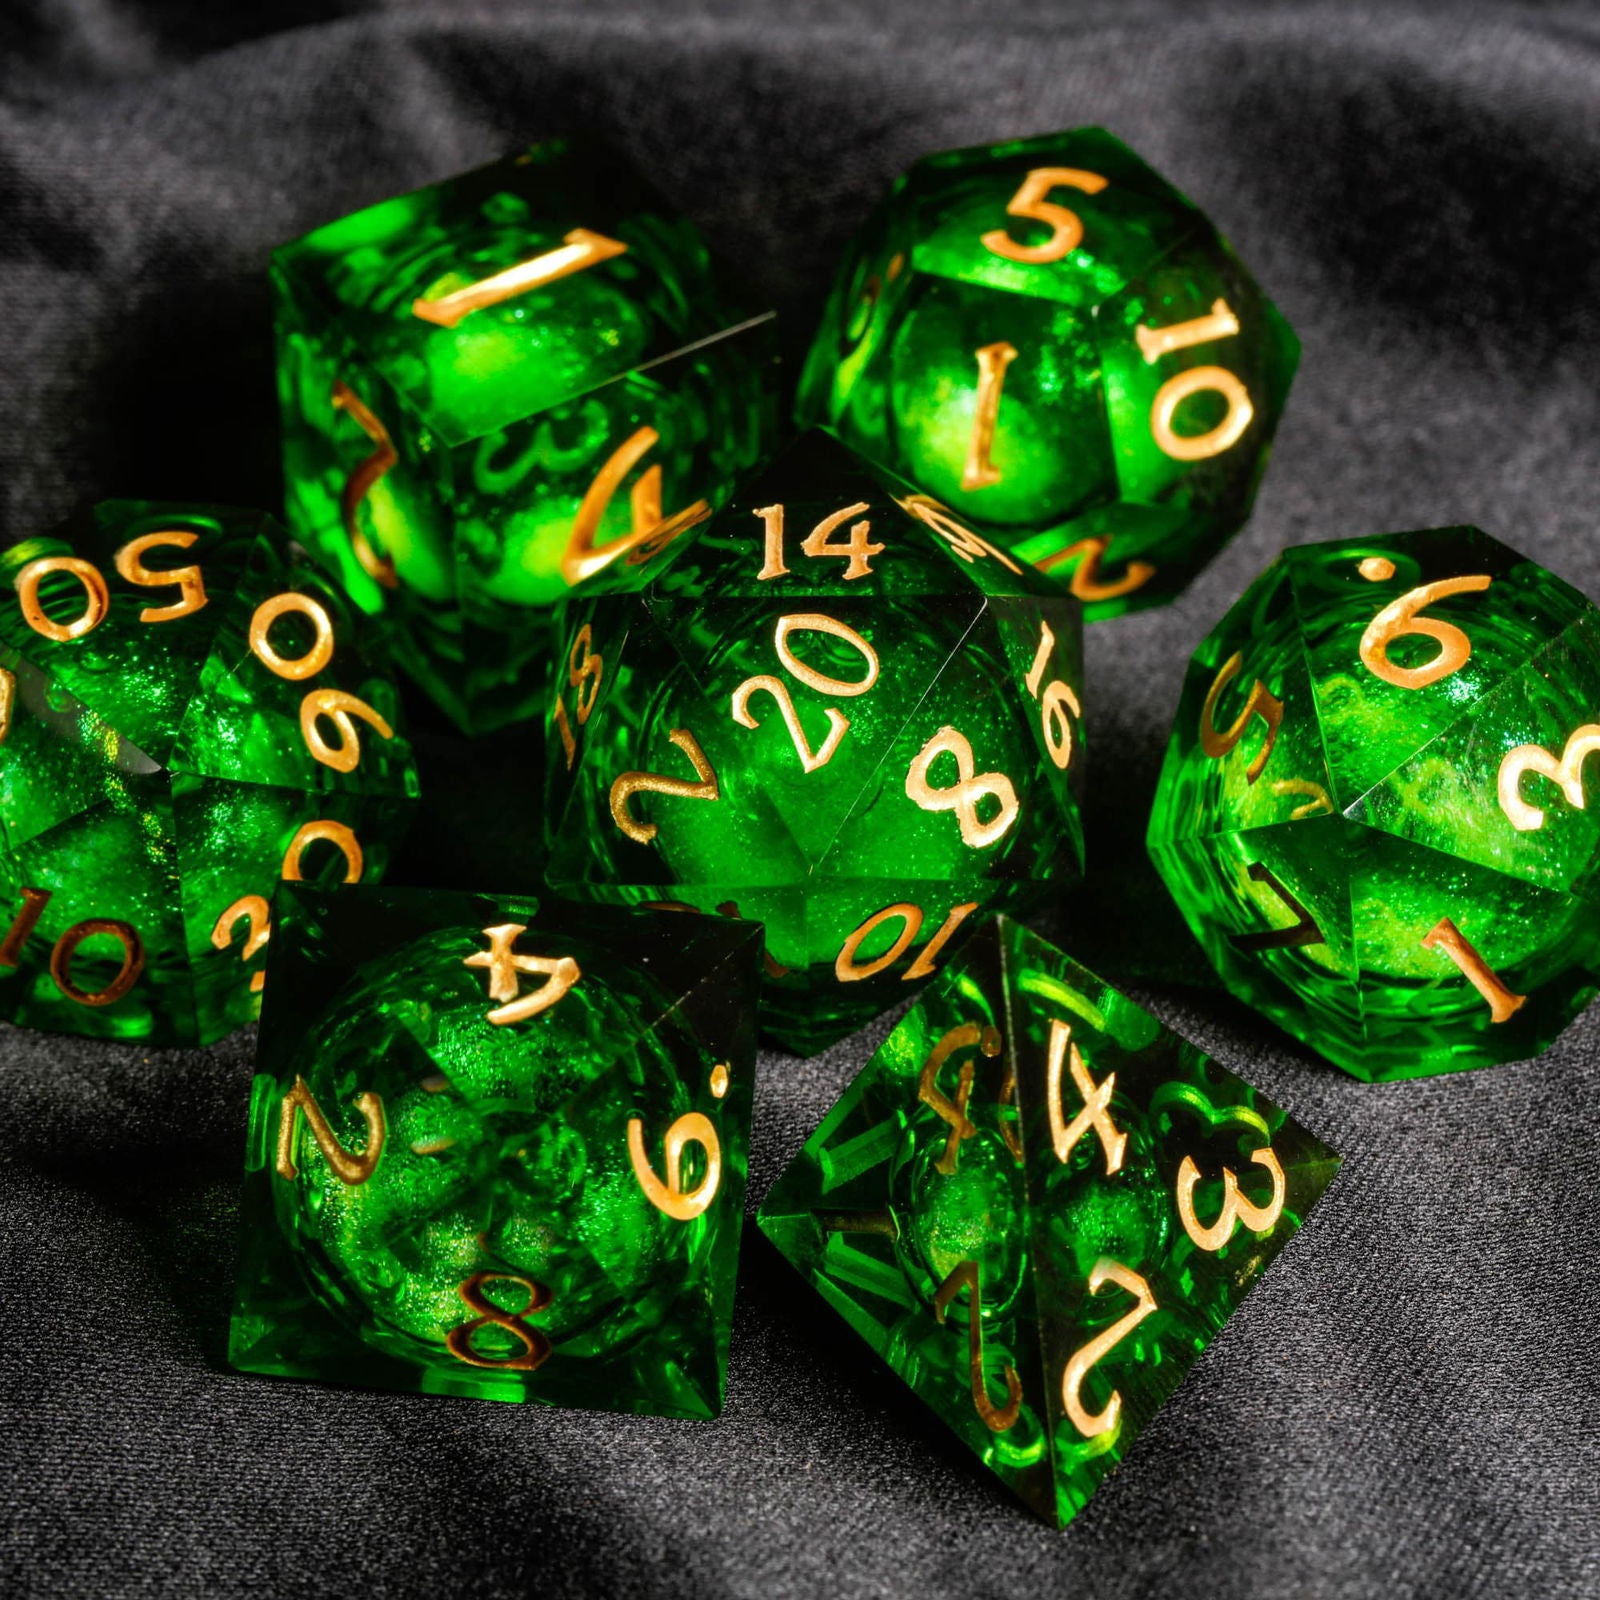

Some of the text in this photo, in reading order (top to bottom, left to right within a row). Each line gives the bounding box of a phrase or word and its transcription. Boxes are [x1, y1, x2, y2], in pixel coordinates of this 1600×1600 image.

[981, 166, 1110, 264] 5
[412, 228, 629, 328] 1
[960, 341, 1018, 491] 1
[1135, 297, 1255, 461] 10
[752, 502, 886, 581] 14
[553, 624, 603, 772] 18
[731, 613, 879, 773] 20
[1025, 620, 1081, 769] 16
[1200, 650, 1285, 786] 5
[610, 728, 719, 845] 2
[905, 726, 1020, 849] 8
[1498, 723, 1600, 831] 3
[463, 923, 582, 1026] 4
[1421, 917, 1528, 1034] 1
[277, 1074, 387, 1186] 2
[1047, 1018, 1128, 1176] 4
[1176, 1147, 1287, 1252] 3
[446, 1273, 554, 1371] 8
[1062, 1259, 1158, 1438] 2
